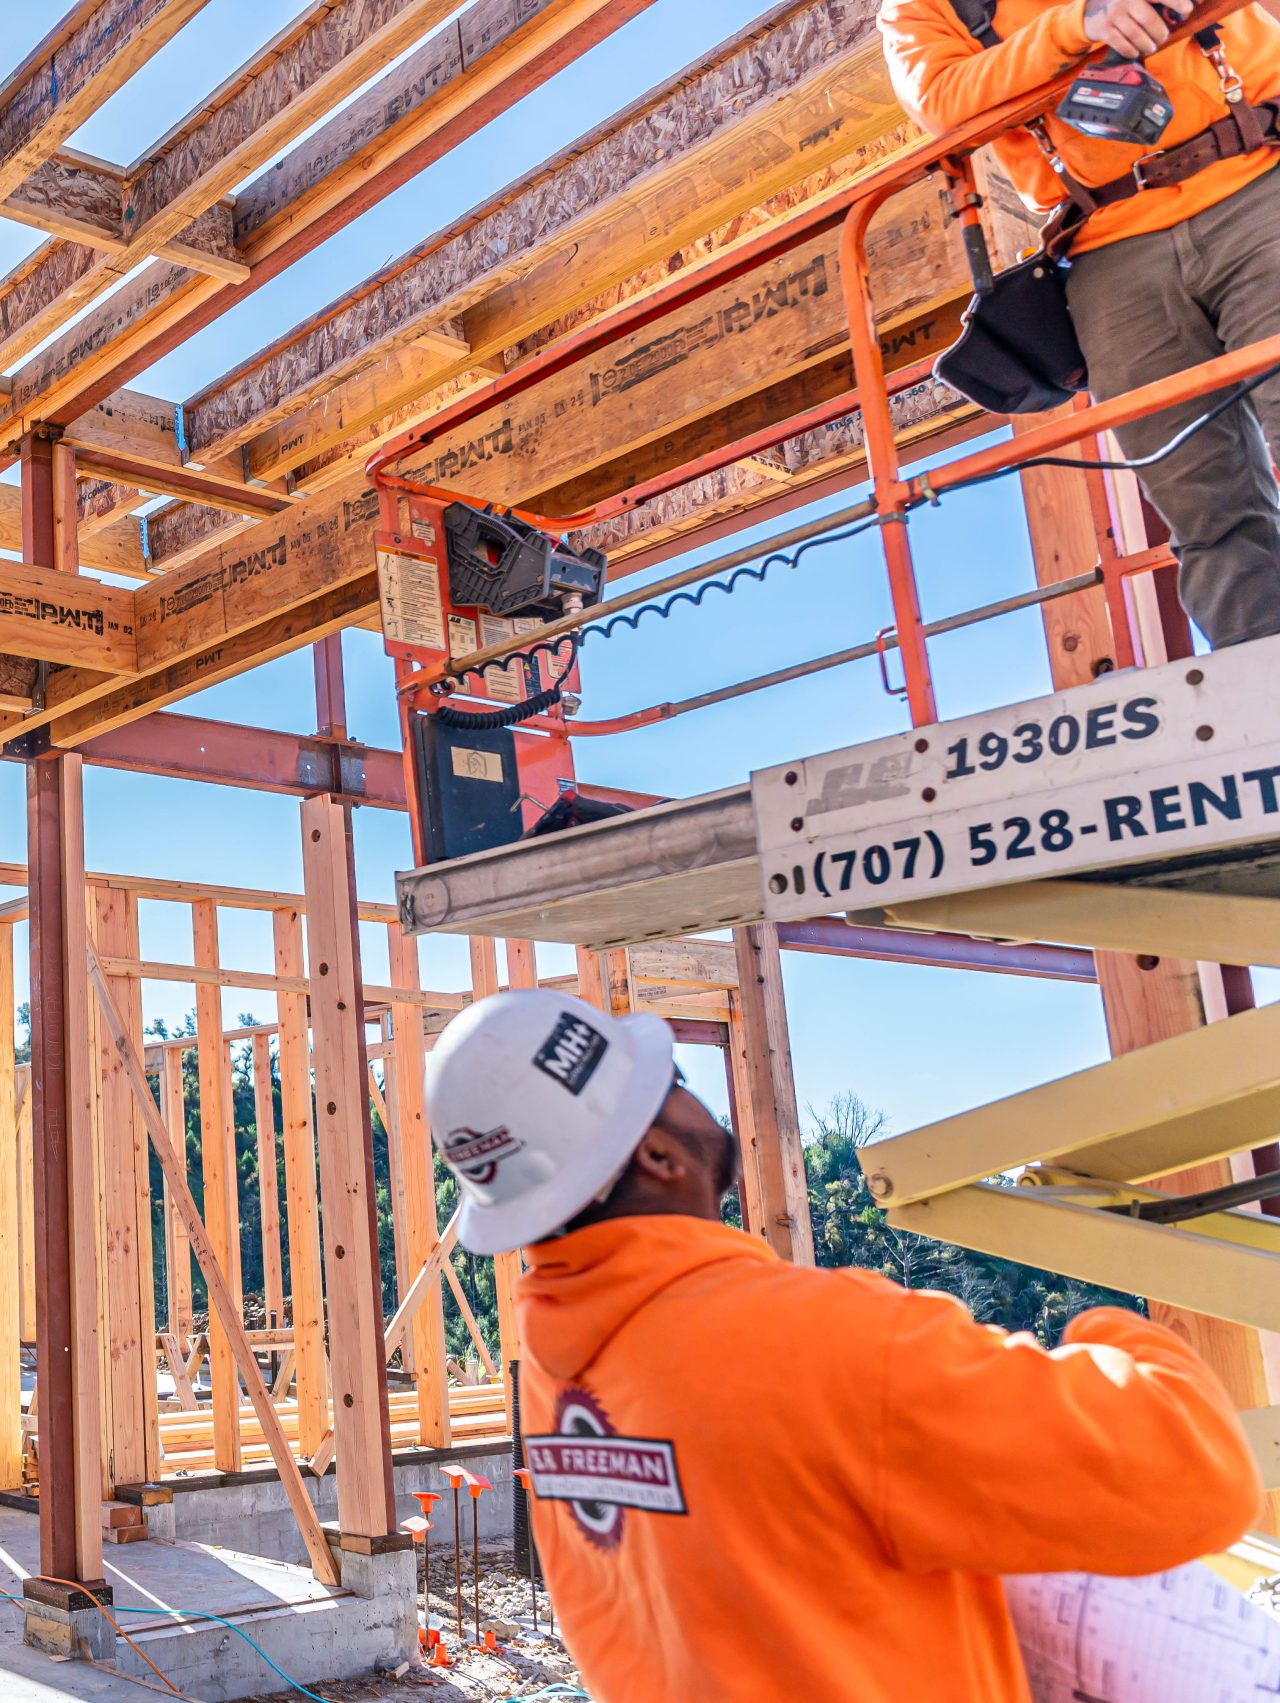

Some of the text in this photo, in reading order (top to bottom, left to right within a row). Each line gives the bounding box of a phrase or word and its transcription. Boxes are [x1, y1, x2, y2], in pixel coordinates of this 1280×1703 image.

[281, 433, 305, 454] PWT
[41, 600, 104, 637] PWT
[122, 623, 133, 635] 02
[195, 648, 223, 671] PWT
[944, 696, 1161, 781] 1930ES
[813, 765, 1280, 899] (707) 528-RENT
[560, 1447, 666, 1482] FREEMAN
